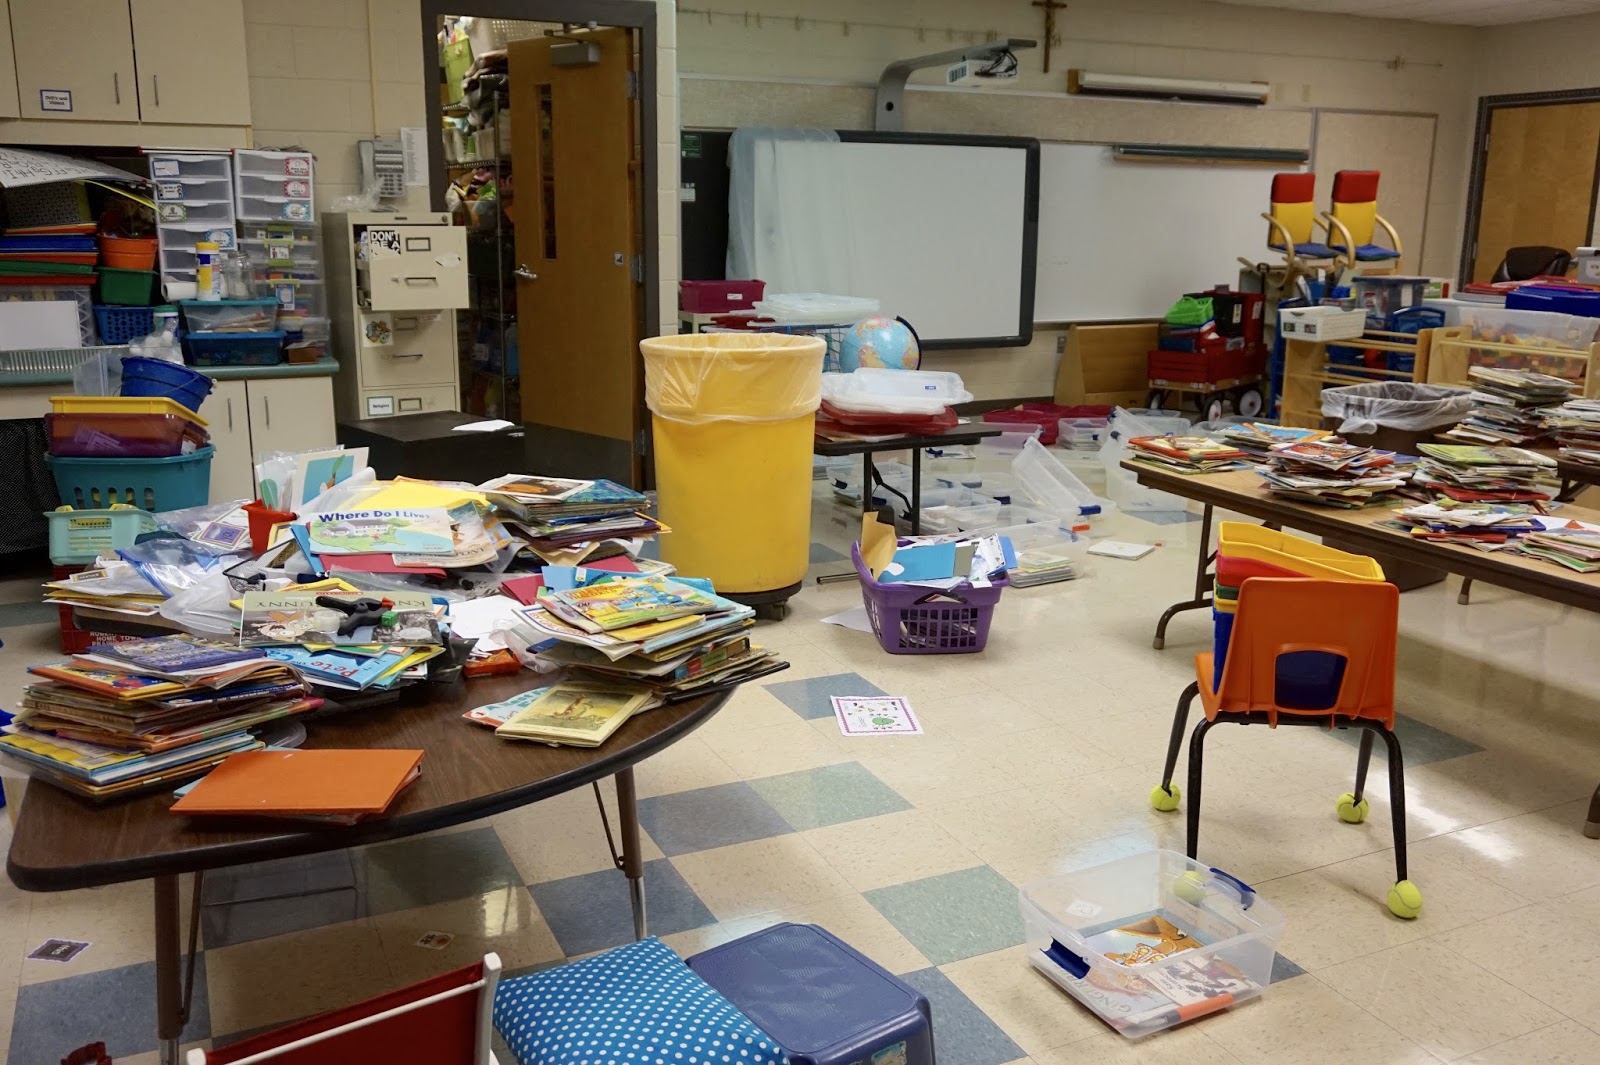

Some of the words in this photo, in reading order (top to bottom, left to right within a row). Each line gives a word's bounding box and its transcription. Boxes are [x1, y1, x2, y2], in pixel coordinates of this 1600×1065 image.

[371, 231, 400, 241] DON'T
[318, 510, 370, 523] Where
[373, 510, 392, 518] Do
[310, 661, 359, 678] Pete
